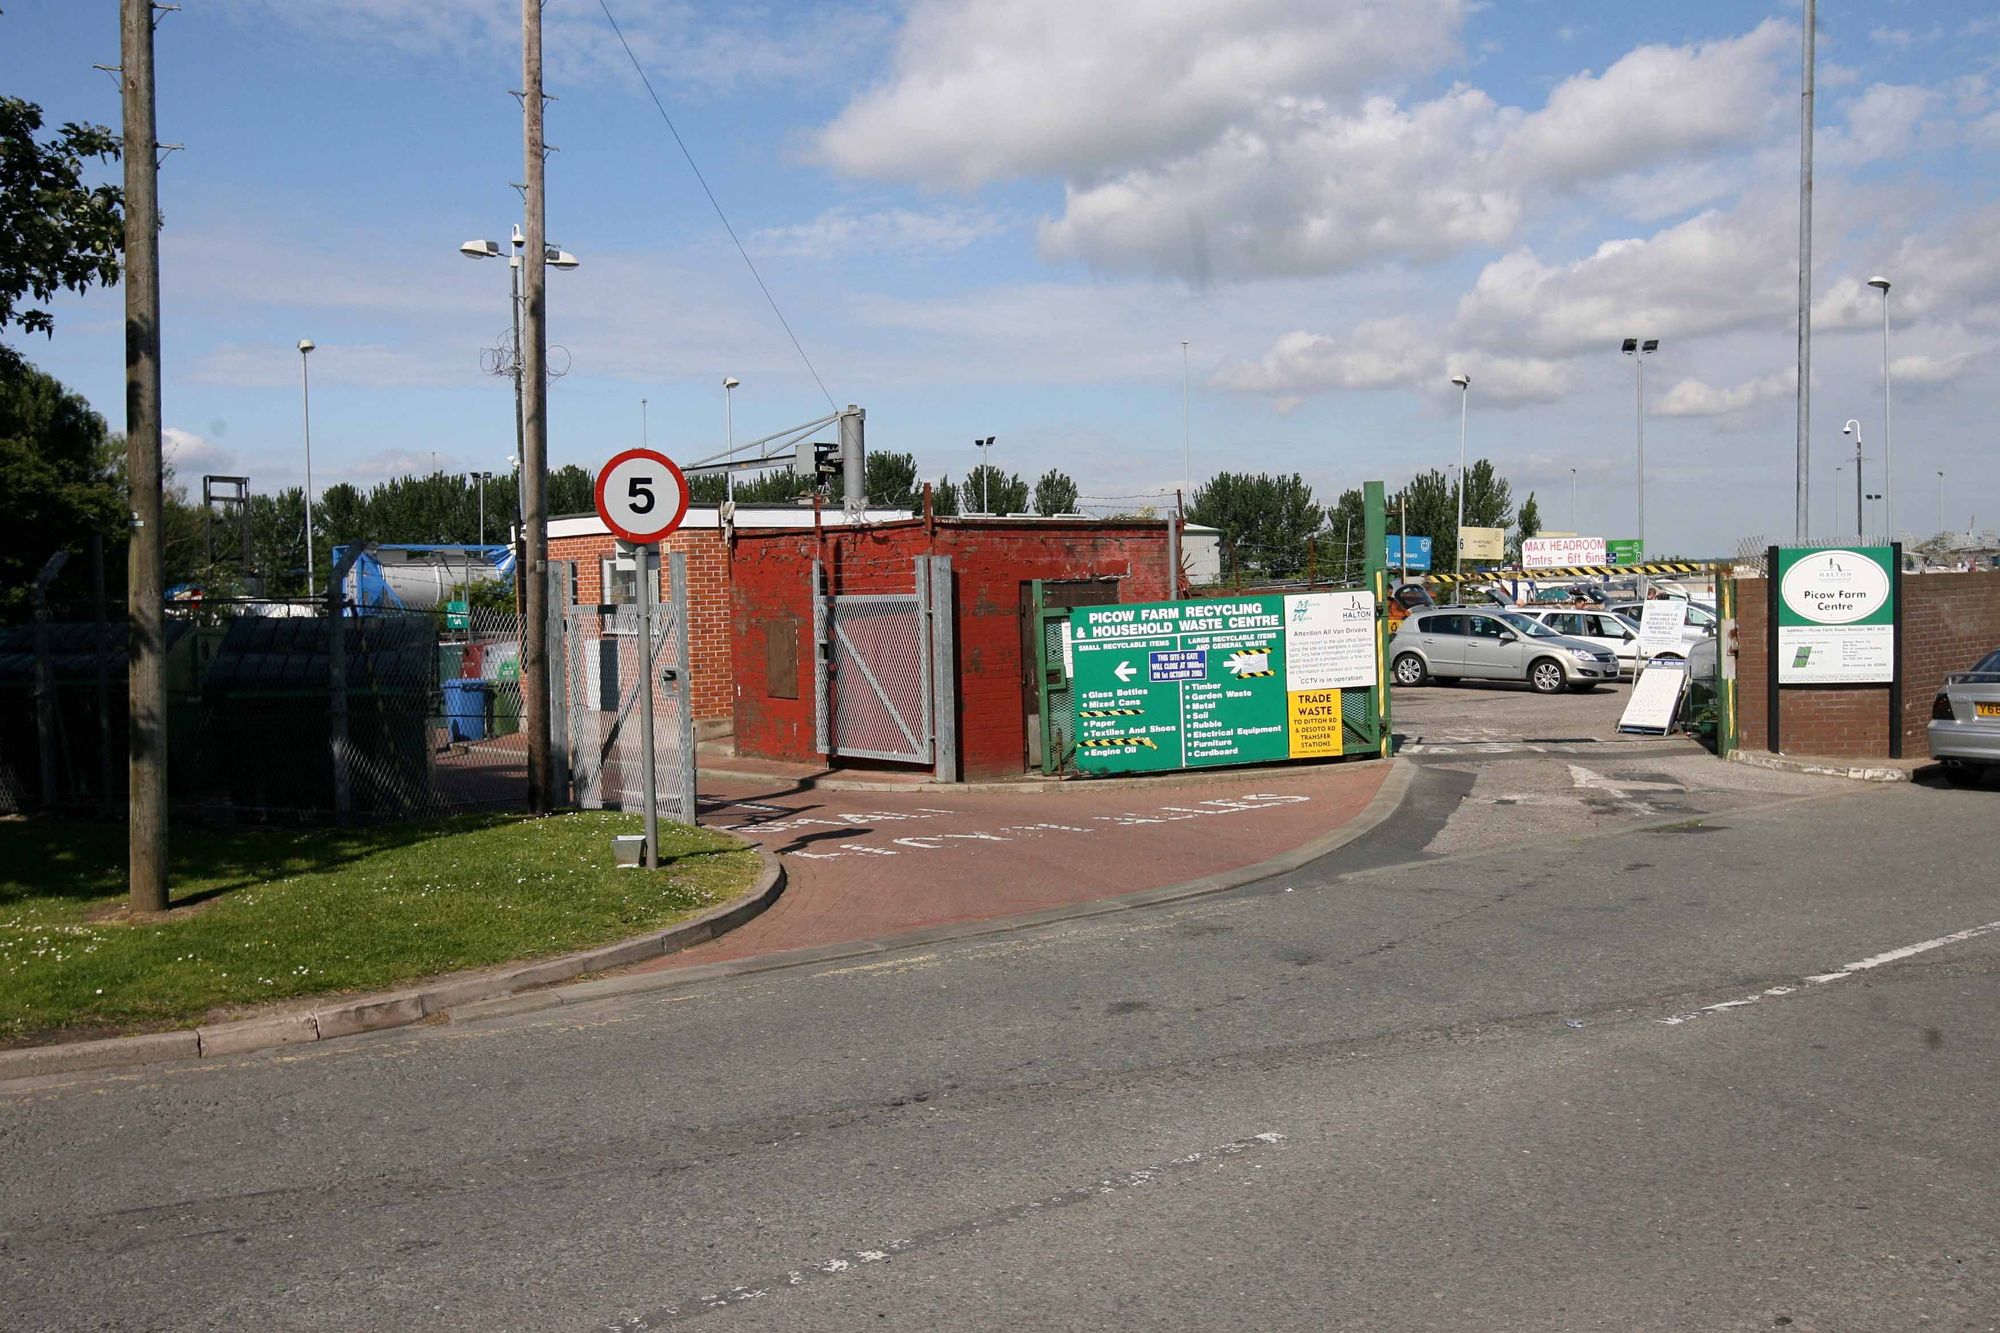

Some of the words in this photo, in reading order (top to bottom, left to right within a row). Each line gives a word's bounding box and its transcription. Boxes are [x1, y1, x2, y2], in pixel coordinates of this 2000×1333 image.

[628, 477, 655, 514] 5
[1524, 541, 1546, 552] MAX
[1549, 539, 1605, 551] HEADROOM
[1526, 554, 1553, 566] 2mtrs
[1567, 552, 1582, 564] 6ft
[1585, 551, 1605, 563] 6ins
[1804, 590, 1835, 599] Picow
[1838, 590, 1867, 599] Farm
[1817, 602, 1853, 611] Centre
[1089, 610, 1135, 624] PICOW
[1141, 608, 1179, 620] FARM
[1185, 603, 1262, 617] RECYCLING
[1342, 610, 1371, 619] HALTON
[1076, 627, 1086, 638] &
[1092, 622, 1173, 637] HOUSEHOLD
[1179, 618, 1223, 631] WASTE
[1228, 615, 1279, 628] CENTRE
[1212, 633, 1254, 643] RECYCLABLE
[1257, 632, 1277, 640] ITEMS
[1078, 643, 1101, 652] SMALL
[1103, 641, 1147, 650] RECYCLABLE
[1212, 641, 1243, 649] GENERAL
[1169, 653, 1180, 661] SITE
[1186, 652, 1198, 660] GATE
[1163, 662, 1179, 670] CLOSE
[1169, 670, 1190, 678] OCTOBER
[1333, 675, 1363, 683] operation
[1191, 682, 1221, 690] Timber
[1088, 691, 1113, 699] Glass
[1116, 688, 1148, 697] Bottles
[1191, 692, 1222, 701] Garden
[1226, 690, 1252, 698] Waste
[1089, 700, 1115, 708] Mixed
[1118, 699, 1141, 707] Cans
[1298, 694, 1332, 704] TRADE
[1192, 702, 1216, 710] Metal
[1298, 706, 1332, 716] WASTE
[1192, 712, 1209, 720] Soil
[1090, 720, 1116, 728] Paper
[1192, 720, 1222, 729] Rubble
[1090, 729, 1125, 737] Textiles
[1128, 726, 1146, 734] And
[1150, 725, 1176, 733] Shoes
[1193, 729, 1233, 738] Electrical
[1237, 725, 1282, 736] Equipment
[1193, 739, 1232, 748] Furniture
[1090, 749, 1121, 757] Engine
[1194, 747, 1238, 757] Cardboard
